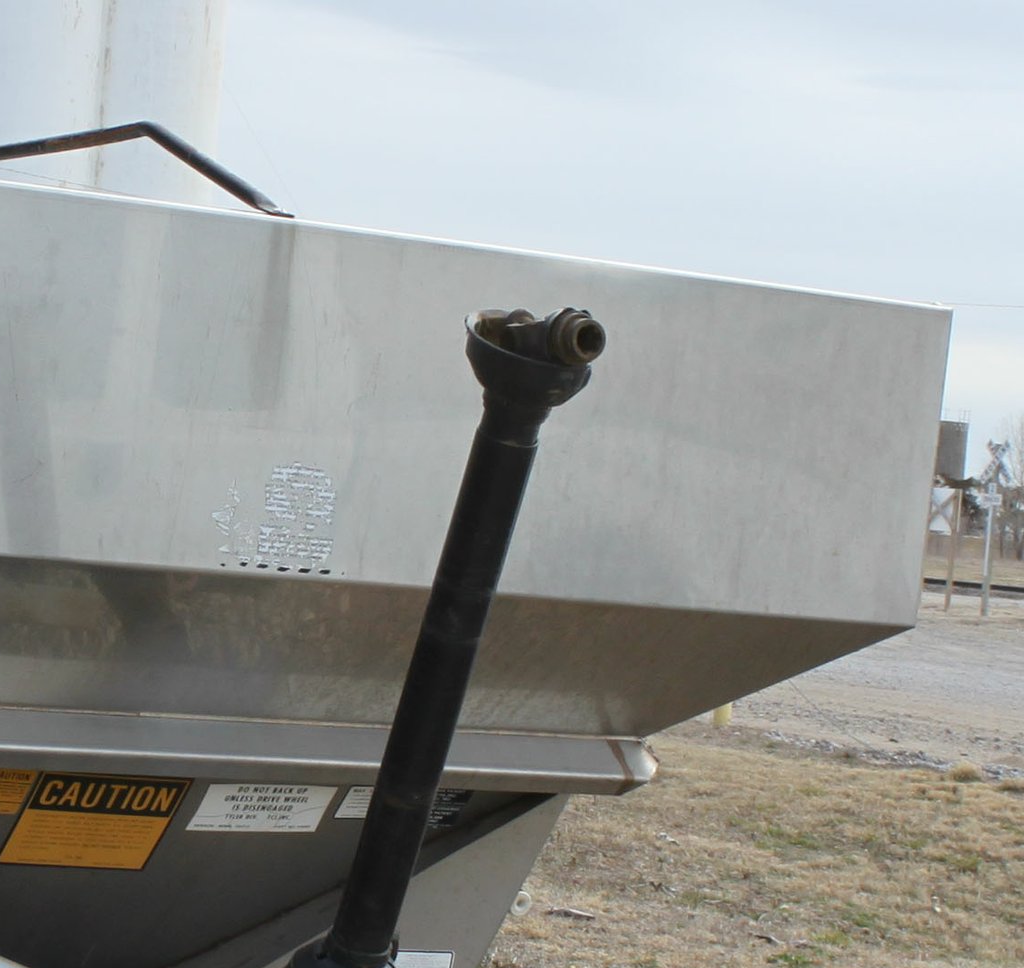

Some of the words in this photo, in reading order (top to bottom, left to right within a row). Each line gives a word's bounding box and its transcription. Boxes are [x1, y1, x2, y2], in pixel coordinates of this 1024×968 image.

[252, 786, 270, 794] NOT
[296, 787, 309, 795] UP
[39, 780, 178, 813] CAUTION
[224, 795, 254, 803] UNLESS
[256, 795, 281, 803] DRIVE
[242, 804, 293, 812] DISENGAGED
